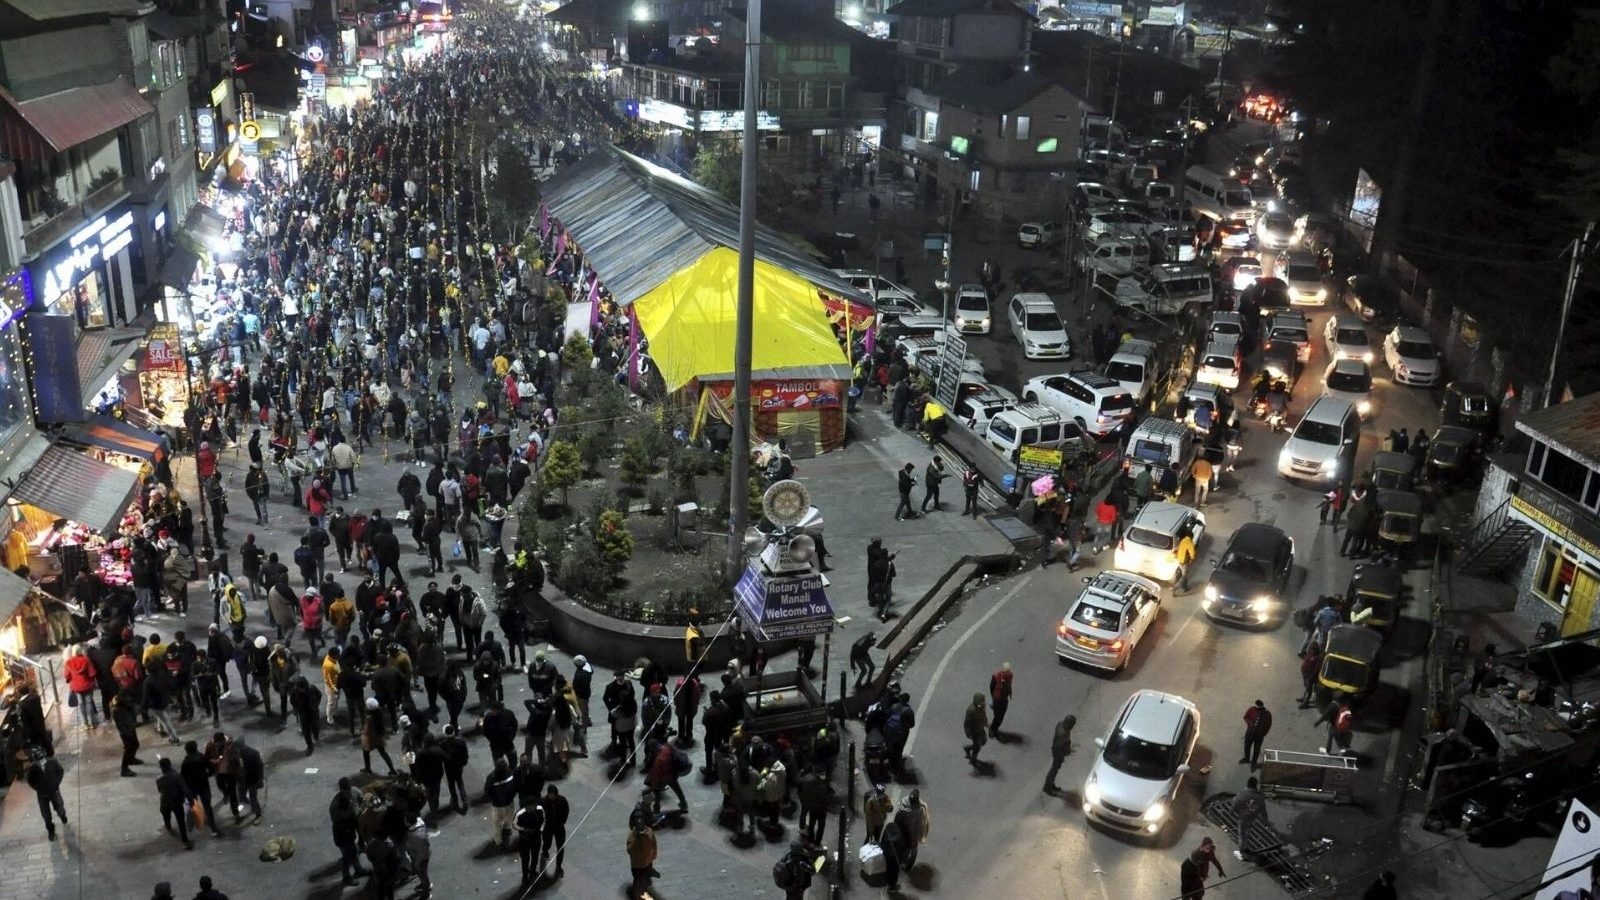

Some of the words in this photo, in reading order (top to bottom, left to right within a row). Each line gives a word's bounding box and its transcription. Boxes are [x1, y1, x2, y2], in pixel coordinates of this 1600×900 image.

[150, 350, 172, 360] SALE
[769, 583, 799, 593] Rotary
[801, 580, 822, 590] Club
[782, 592, 810, 604] Manali
[766, 606, 808, 619] Welcome
[810, 604, 827, 614] You
